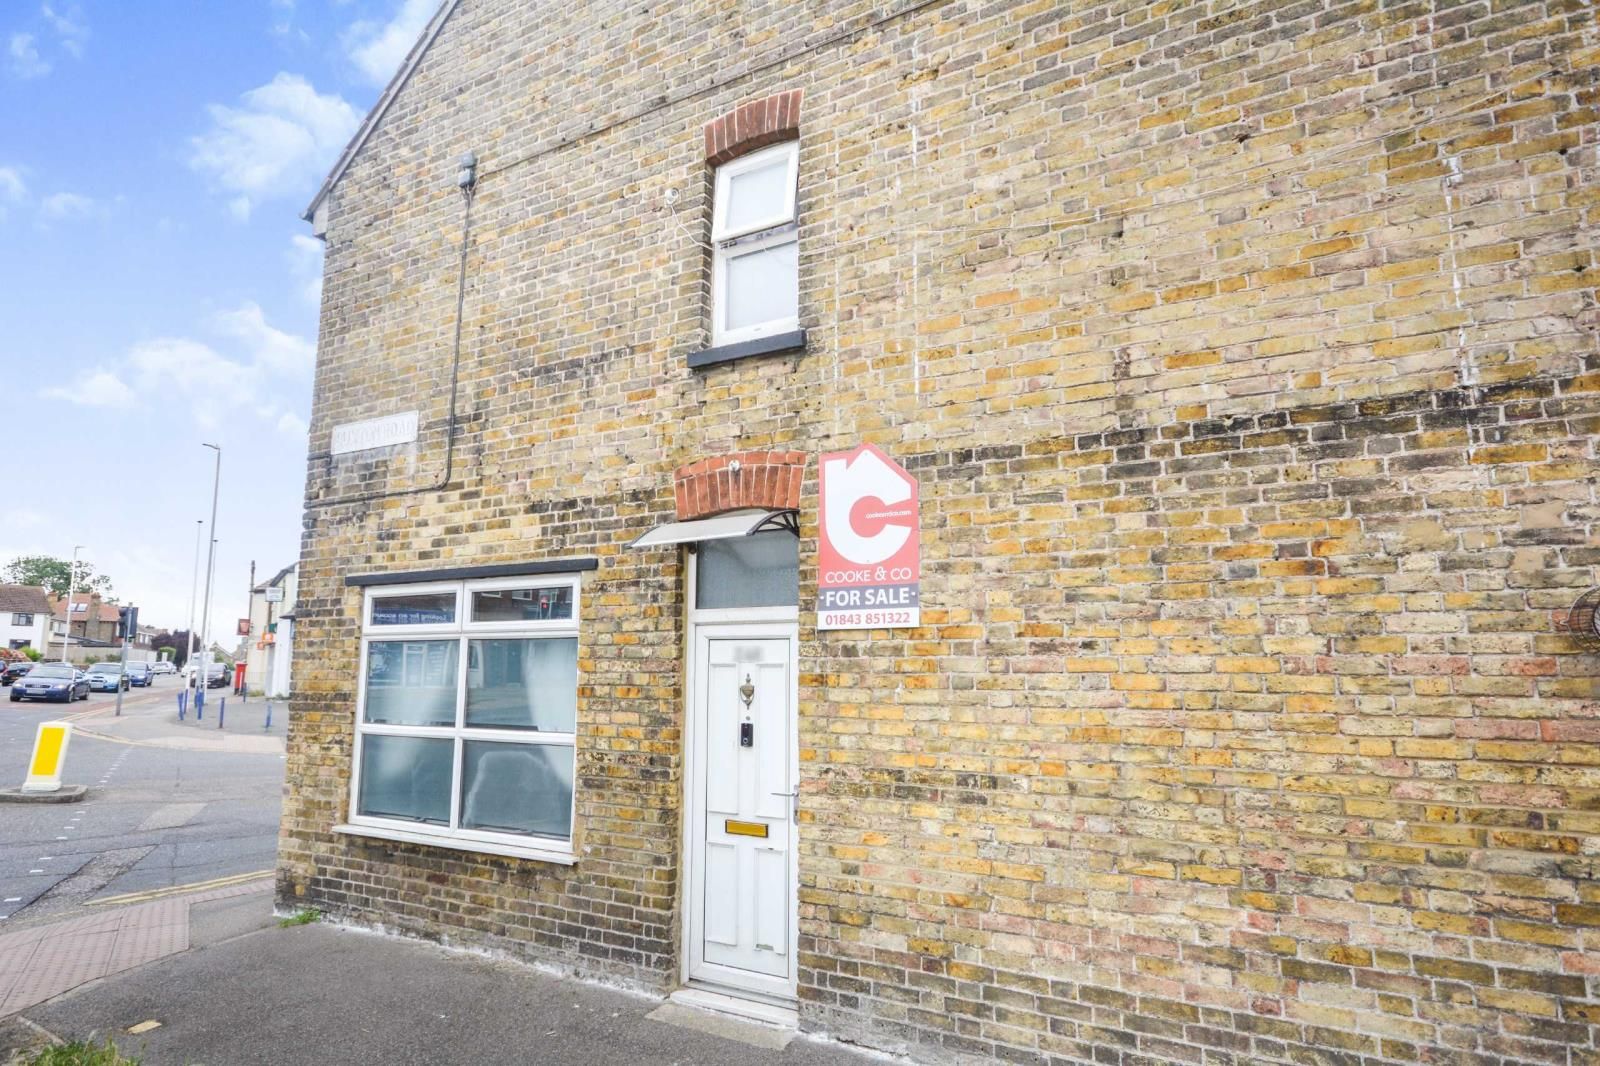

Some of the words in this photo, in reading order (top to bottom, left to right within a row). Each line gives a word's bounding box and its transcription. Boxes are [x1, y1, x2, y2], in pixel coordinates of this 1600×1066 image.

[825, 570, 871, 583] COOKE
[875, 566, 887, 581] &
[890, 567, 912, 580] CO
[825, 590, 861, 607] FOR
[864, 587, 910, 605] SALE
[825, 614, 861, 626] 01843
[865, 612, 910, 624] 851322
